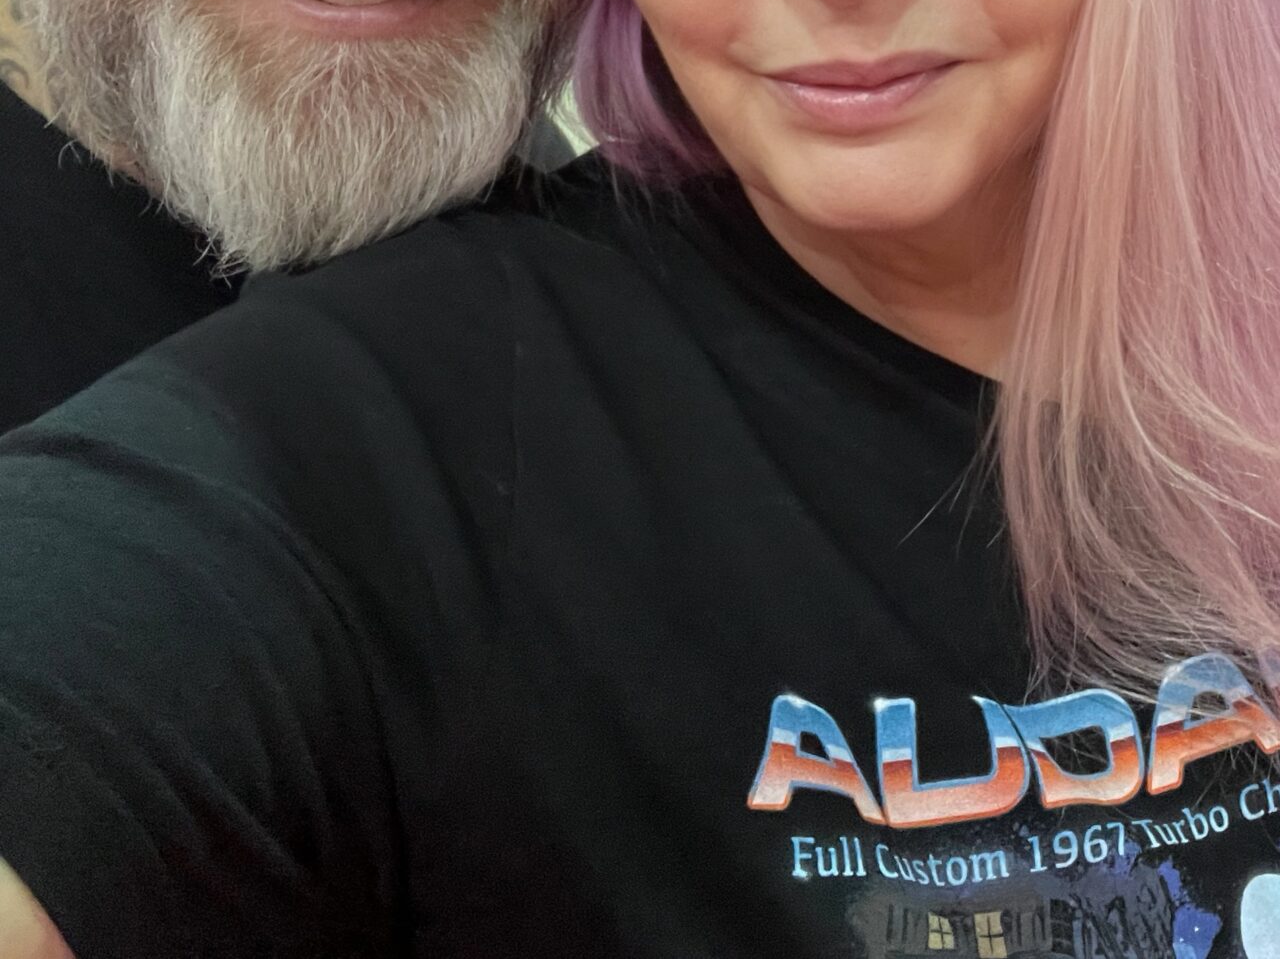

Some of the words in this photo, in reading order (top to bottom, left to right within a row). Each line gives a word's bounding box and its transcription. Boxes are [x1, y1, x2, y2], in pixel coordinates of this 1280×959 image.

[790, 836, 867, 878] Full
[875, 843, 1010, 887] Custom
[1028, 822, 1126, 873] 1967
[1132, 805, 1230, 848] Turbo
